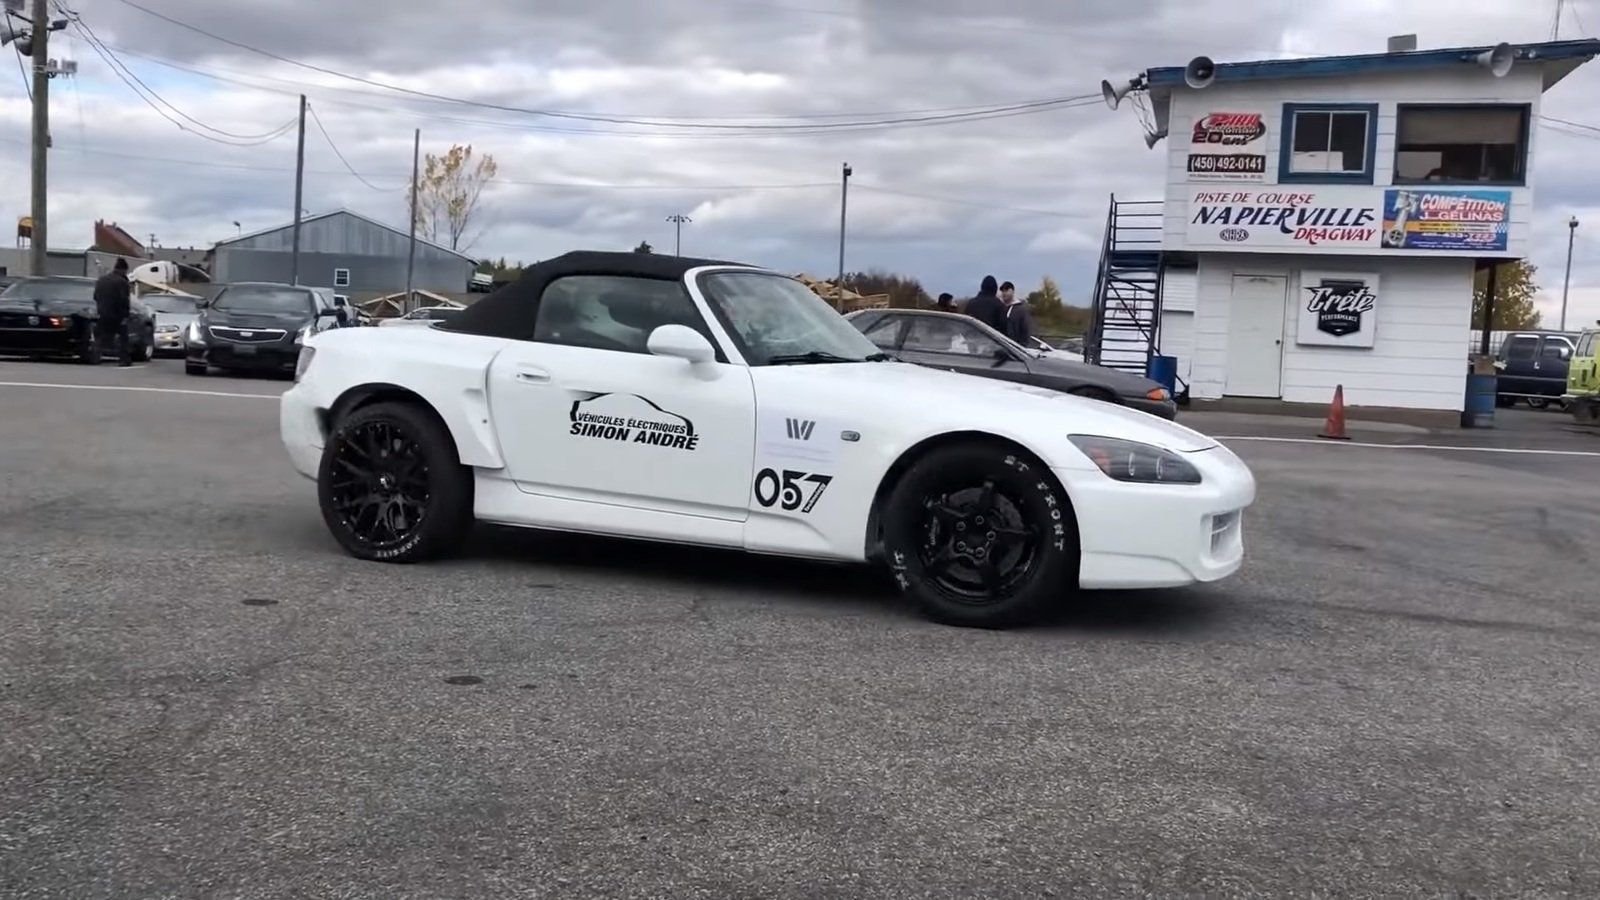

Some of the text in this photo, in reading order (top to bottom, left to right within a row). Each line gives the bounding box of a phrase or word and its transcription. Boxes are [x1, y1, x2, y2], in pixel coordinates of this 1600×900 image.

[1192, 132, 1223, 144] 20
[1191, 156, 1263, 172] (450) 492-0141
[1194, 192, 1315, 206] PISTE DE COURSE
[1192, 206, 1376, 234] NAPIERVILLE
[1220, 229, 1249, 241] NHRA
[1293, 228, 1377, 245] DRAGWAY
[578, 412, 687, 435] VÉHICULES ÉLECTRIQUES
[569, 422, 700, 450] SIMON ANDRÉ
[754, 468, 834, 514] 057
